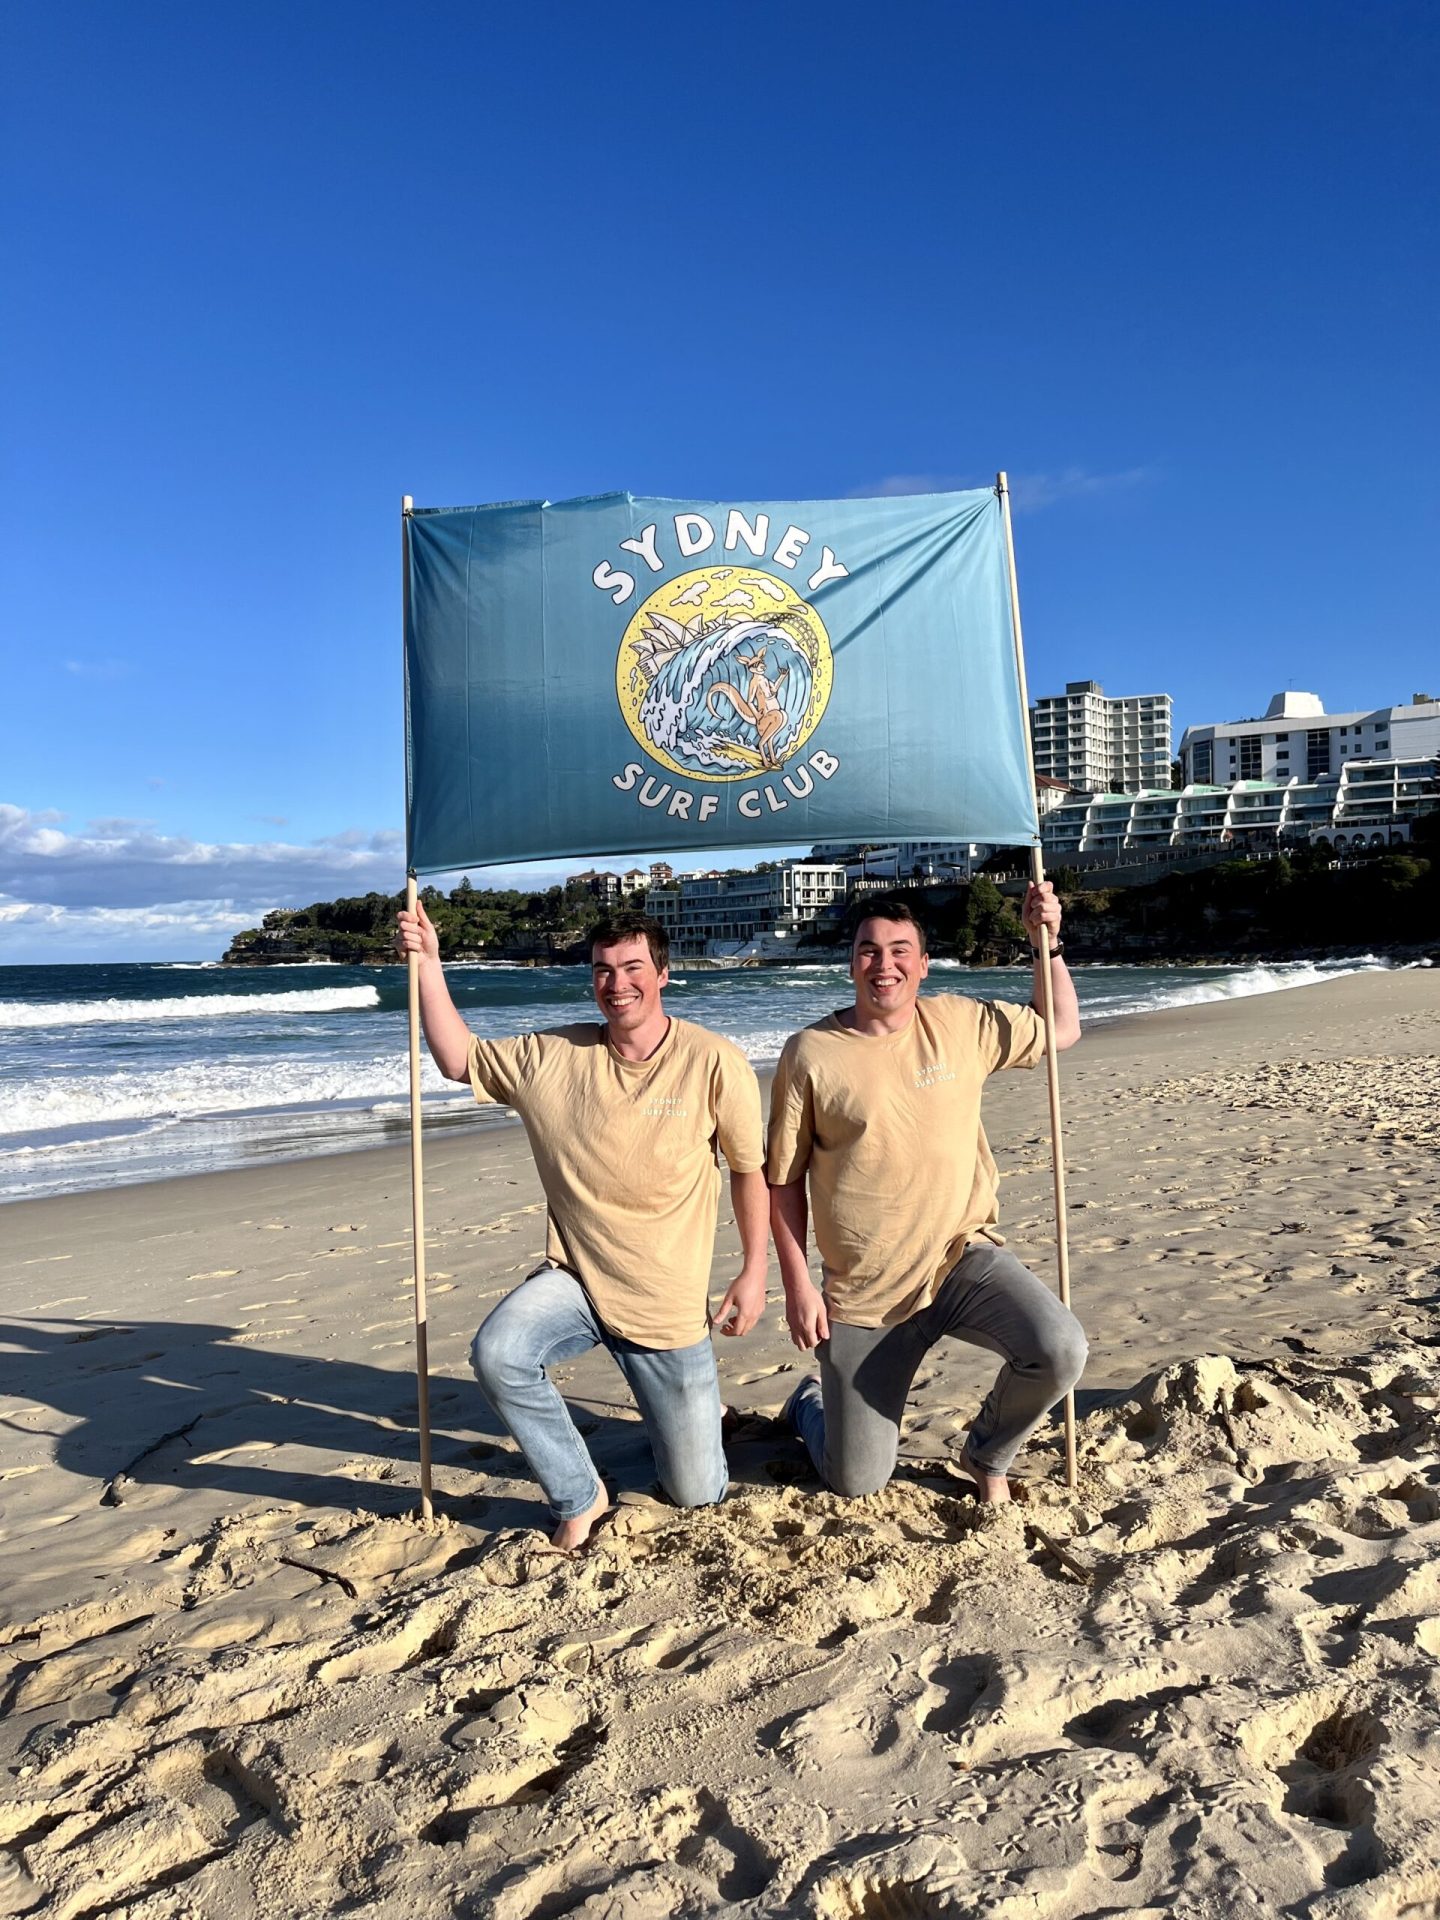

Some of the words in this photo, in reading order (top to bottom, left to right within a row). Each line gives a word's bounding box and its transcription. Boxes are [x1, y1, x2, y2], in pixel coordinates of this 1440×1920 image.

[592, 509, 850, 605] SYDNEY
[612, 762, 720, 822] SURF
[738, 750, 840, 818] CLUB
[915, 1063, 946, 1076] SYDNE
